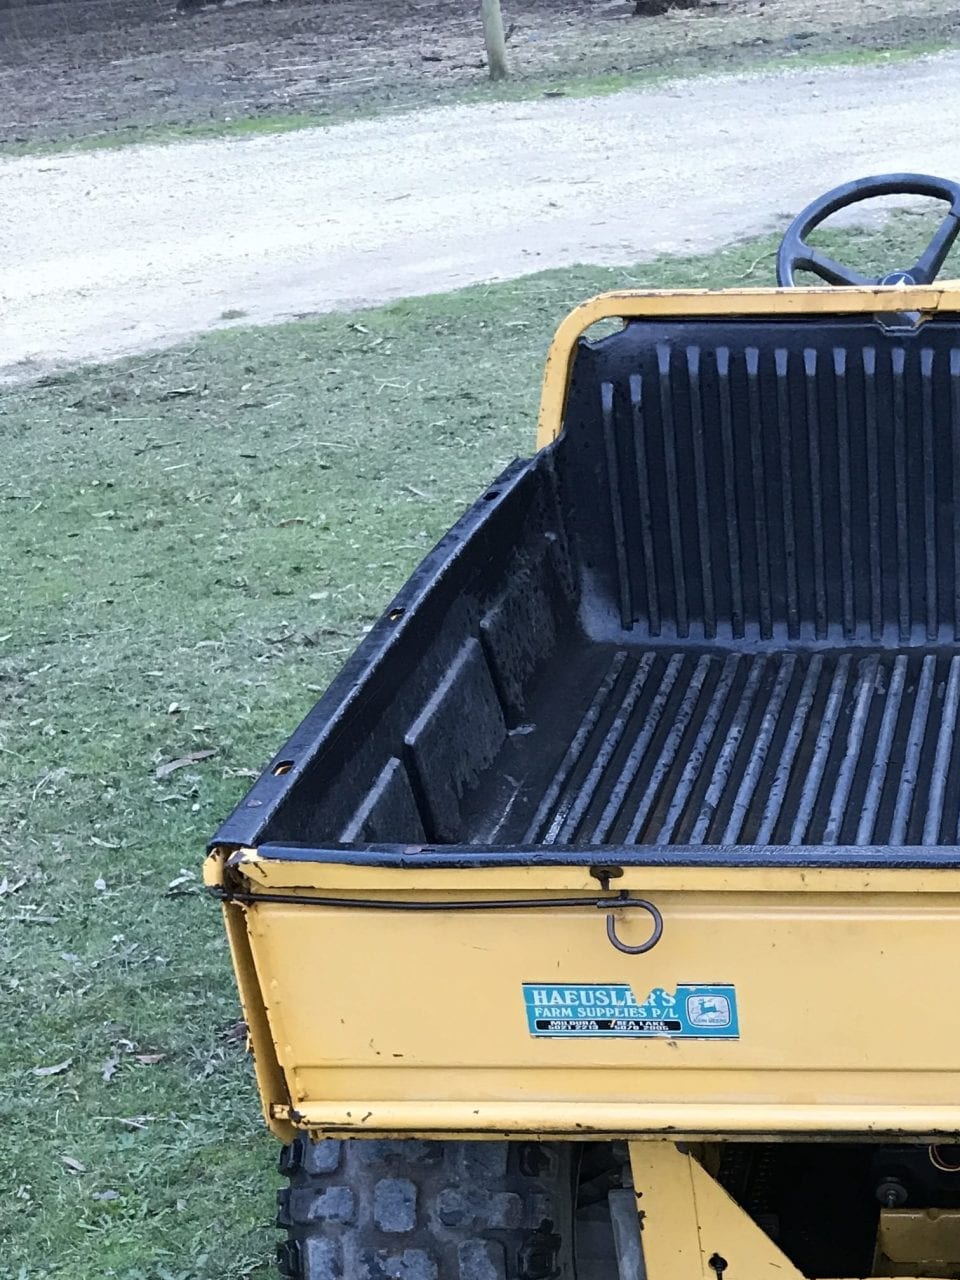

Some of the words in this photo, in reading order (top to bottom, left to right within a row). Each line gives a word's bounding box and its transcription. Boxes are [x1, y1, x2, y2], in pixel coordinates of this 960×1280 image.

[532, 990, 676, 1007] HAEUSLER'S
[535, 1007, 574, 1017] FARM
[577, 1007, 647, 1018] SUPPLIES
[652, 1007, 679, 1018] P/L
